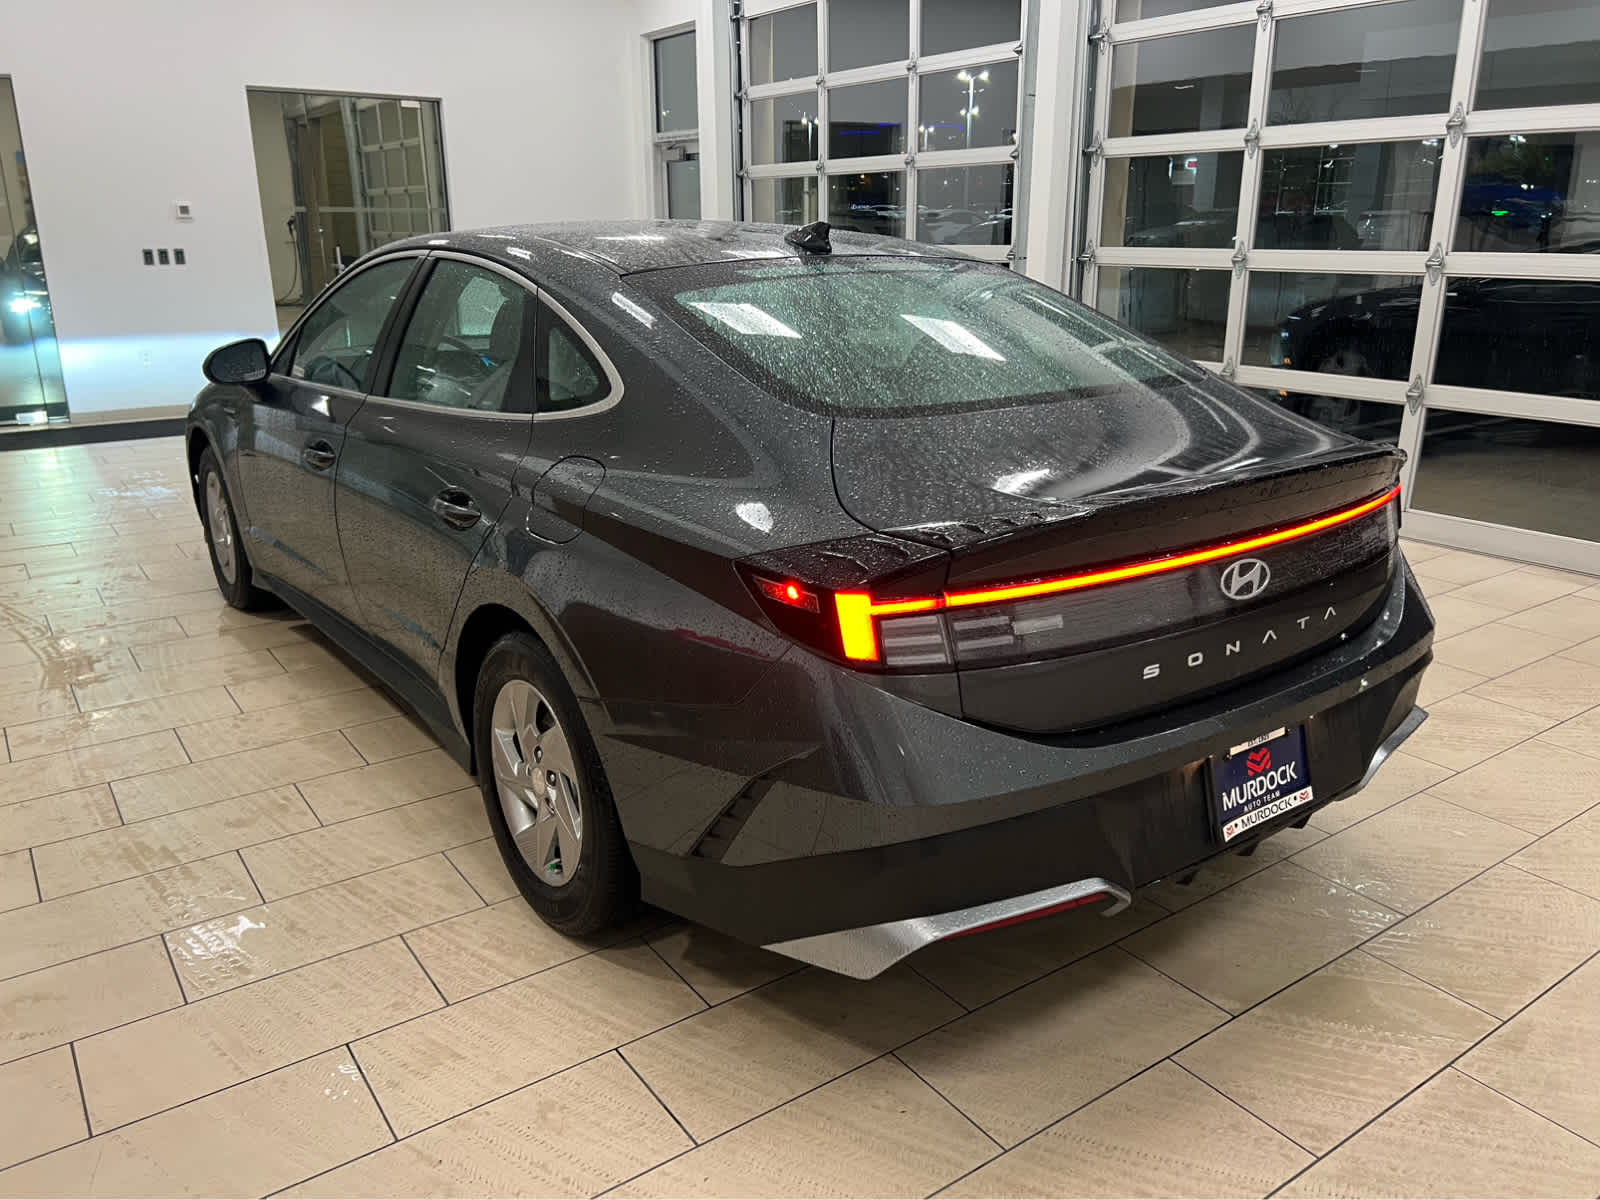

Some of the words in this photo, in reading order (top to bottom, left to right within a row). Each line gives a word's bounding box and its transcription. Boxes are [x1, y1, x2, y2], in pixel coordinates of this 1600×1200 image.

[1143, 606, 1336, 680] SONATA
[1222, 761, 1298, 811] MURDOCK
[1243, 799, 1262, 812] AUTO
[1263, 790, 1281, 803] TEAM
[1241, 797, 1292, 829] MURDOCK
